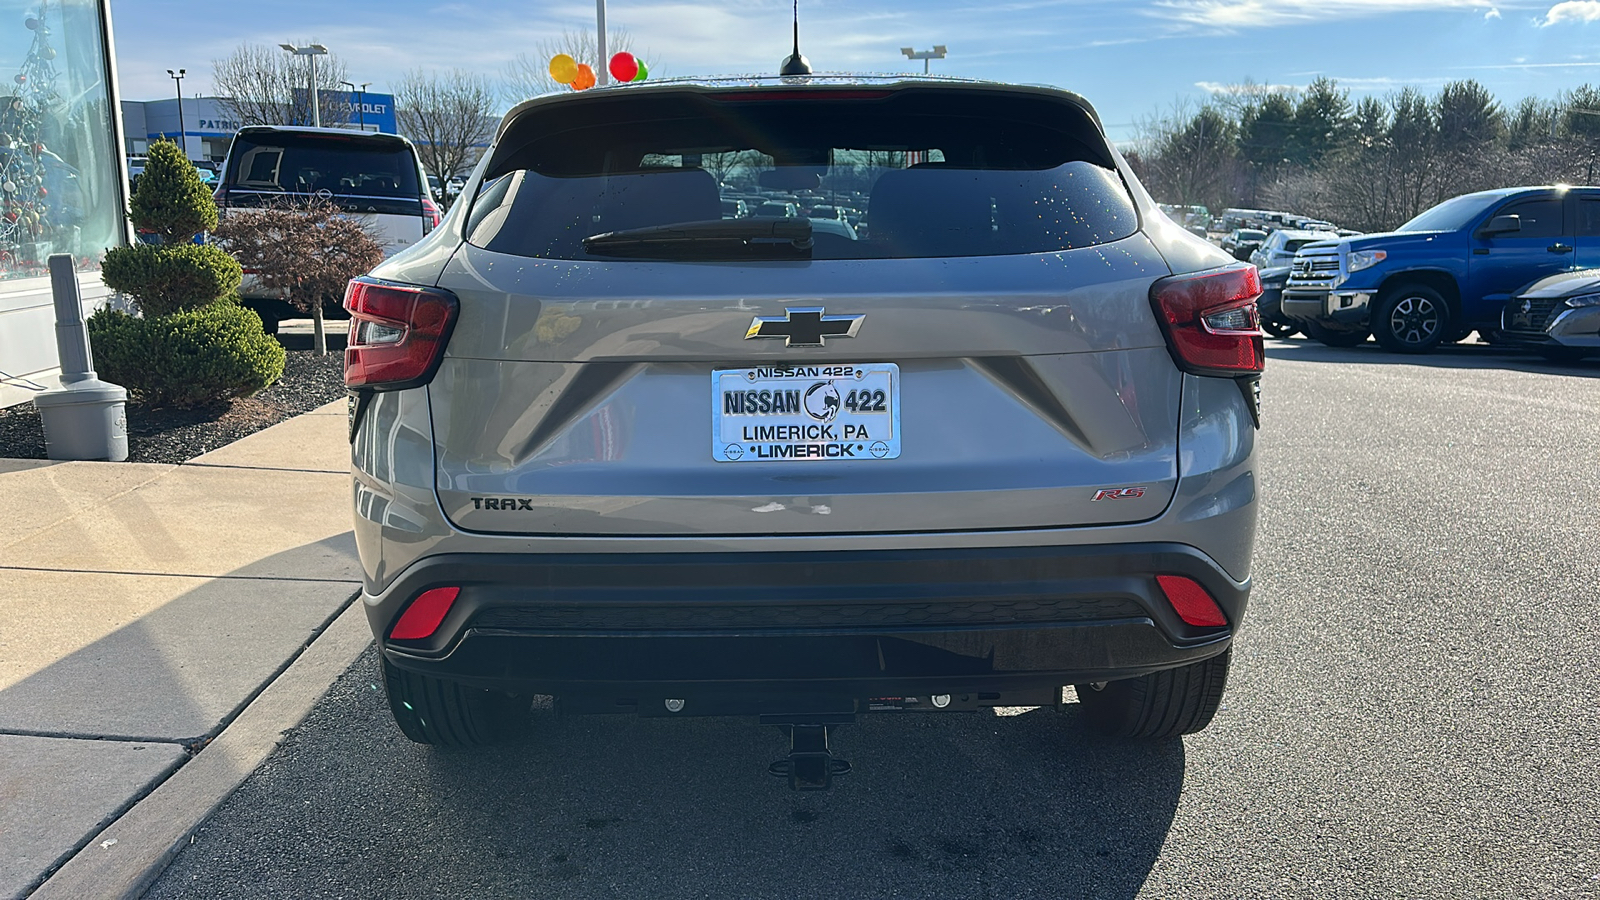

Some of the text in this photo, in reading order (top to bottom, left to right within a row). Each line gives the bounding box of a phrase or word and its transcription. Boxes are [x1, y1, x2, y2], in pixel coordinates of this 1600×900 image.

[757, 367, 854, 378] NISSAN 422
[724, 390, 887, 415] NISSAN 422
[743, 425, 869, 441] LIMERICK, PA
[757, 444, 855, 458] LIMERICK
[1090, 486, 1148, 502] RS
[470, 497, 534, 511] TRAX
